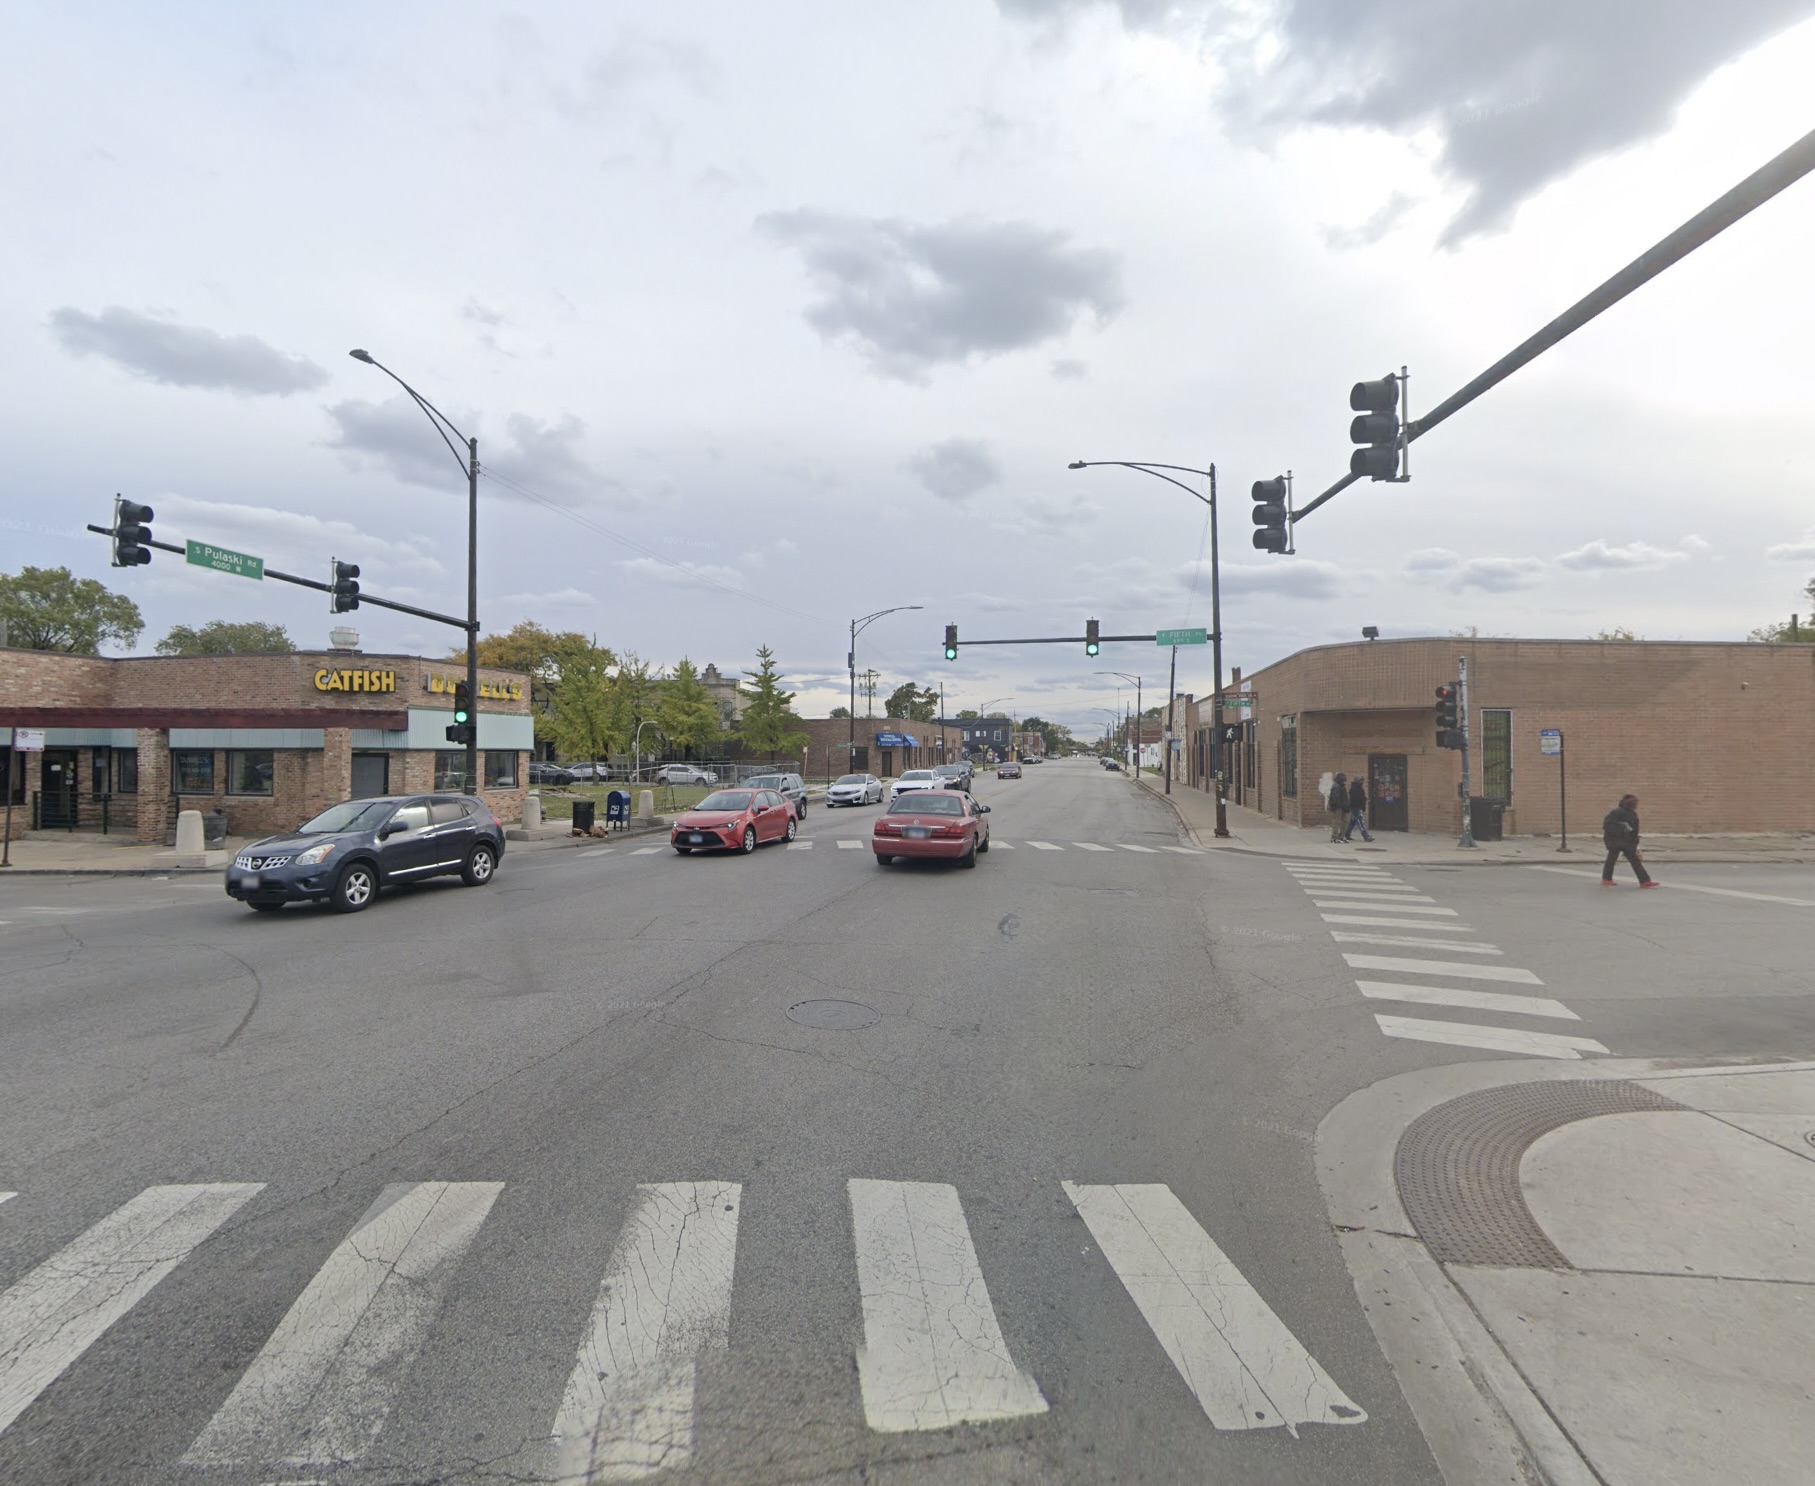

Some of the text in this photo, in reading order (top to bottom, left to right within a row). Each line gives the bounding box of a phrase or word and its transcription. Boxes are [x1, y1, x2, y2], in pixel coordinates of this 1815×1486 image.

[195, 546, 257, 568] S Pulaski Rd
[211, 560, 231, 571] 4000
[1169, 631, 1191, 639] FIFTH
[313, 668, 396, 693] CATFISH
[427, 672, 522, 700] DUELL'S
